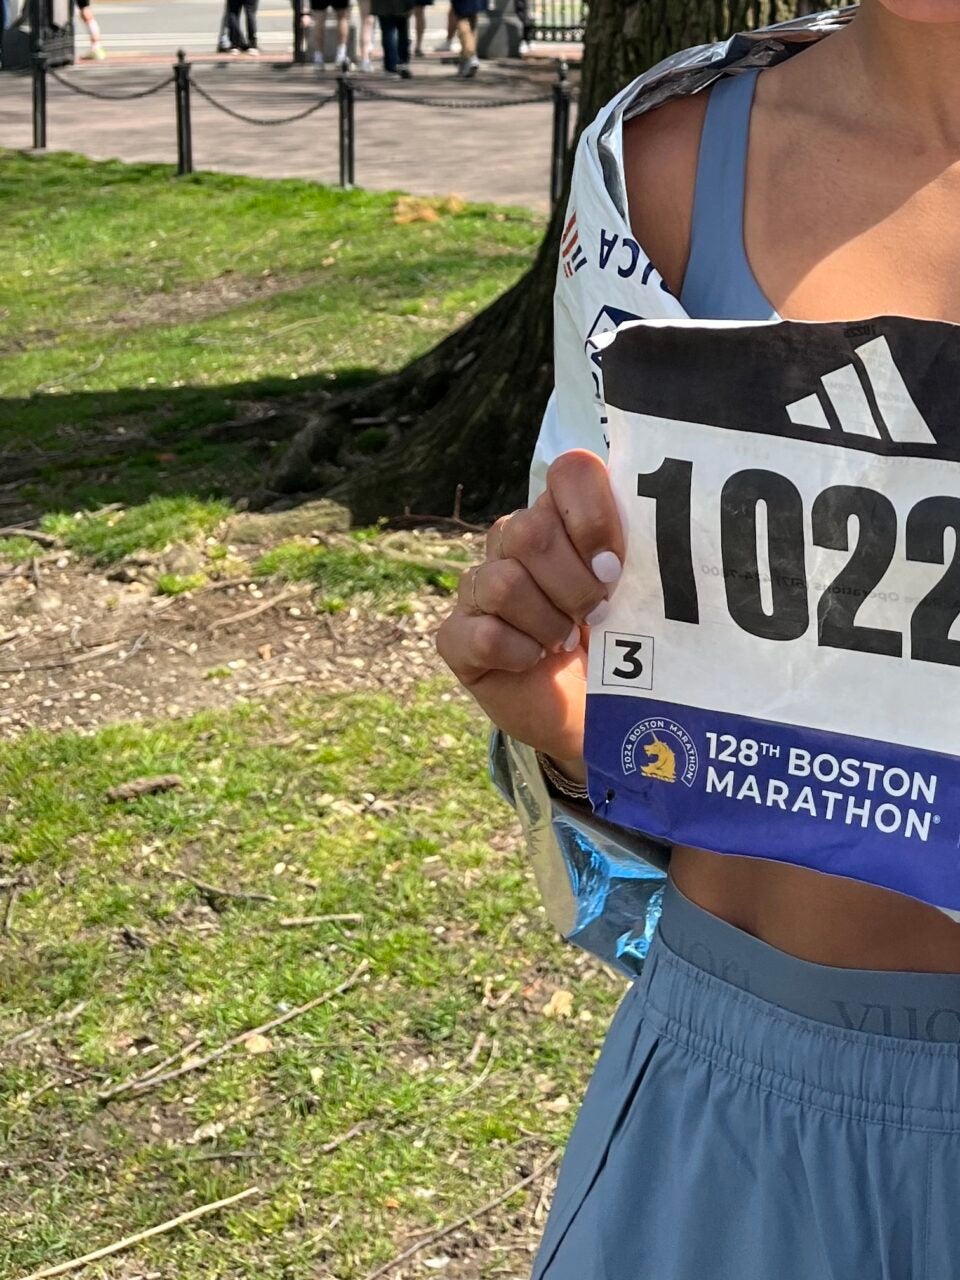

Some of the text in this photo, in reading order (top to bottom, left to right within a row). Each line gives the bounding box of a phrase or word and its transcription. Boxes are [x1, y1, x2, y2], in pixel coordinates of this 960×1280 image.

[612, 639, 643, 680] 3
[624, 720, 696, 780] 2024 BOSTON MARATHON
[705, 732, 937, 805] 128TH BOSTON
